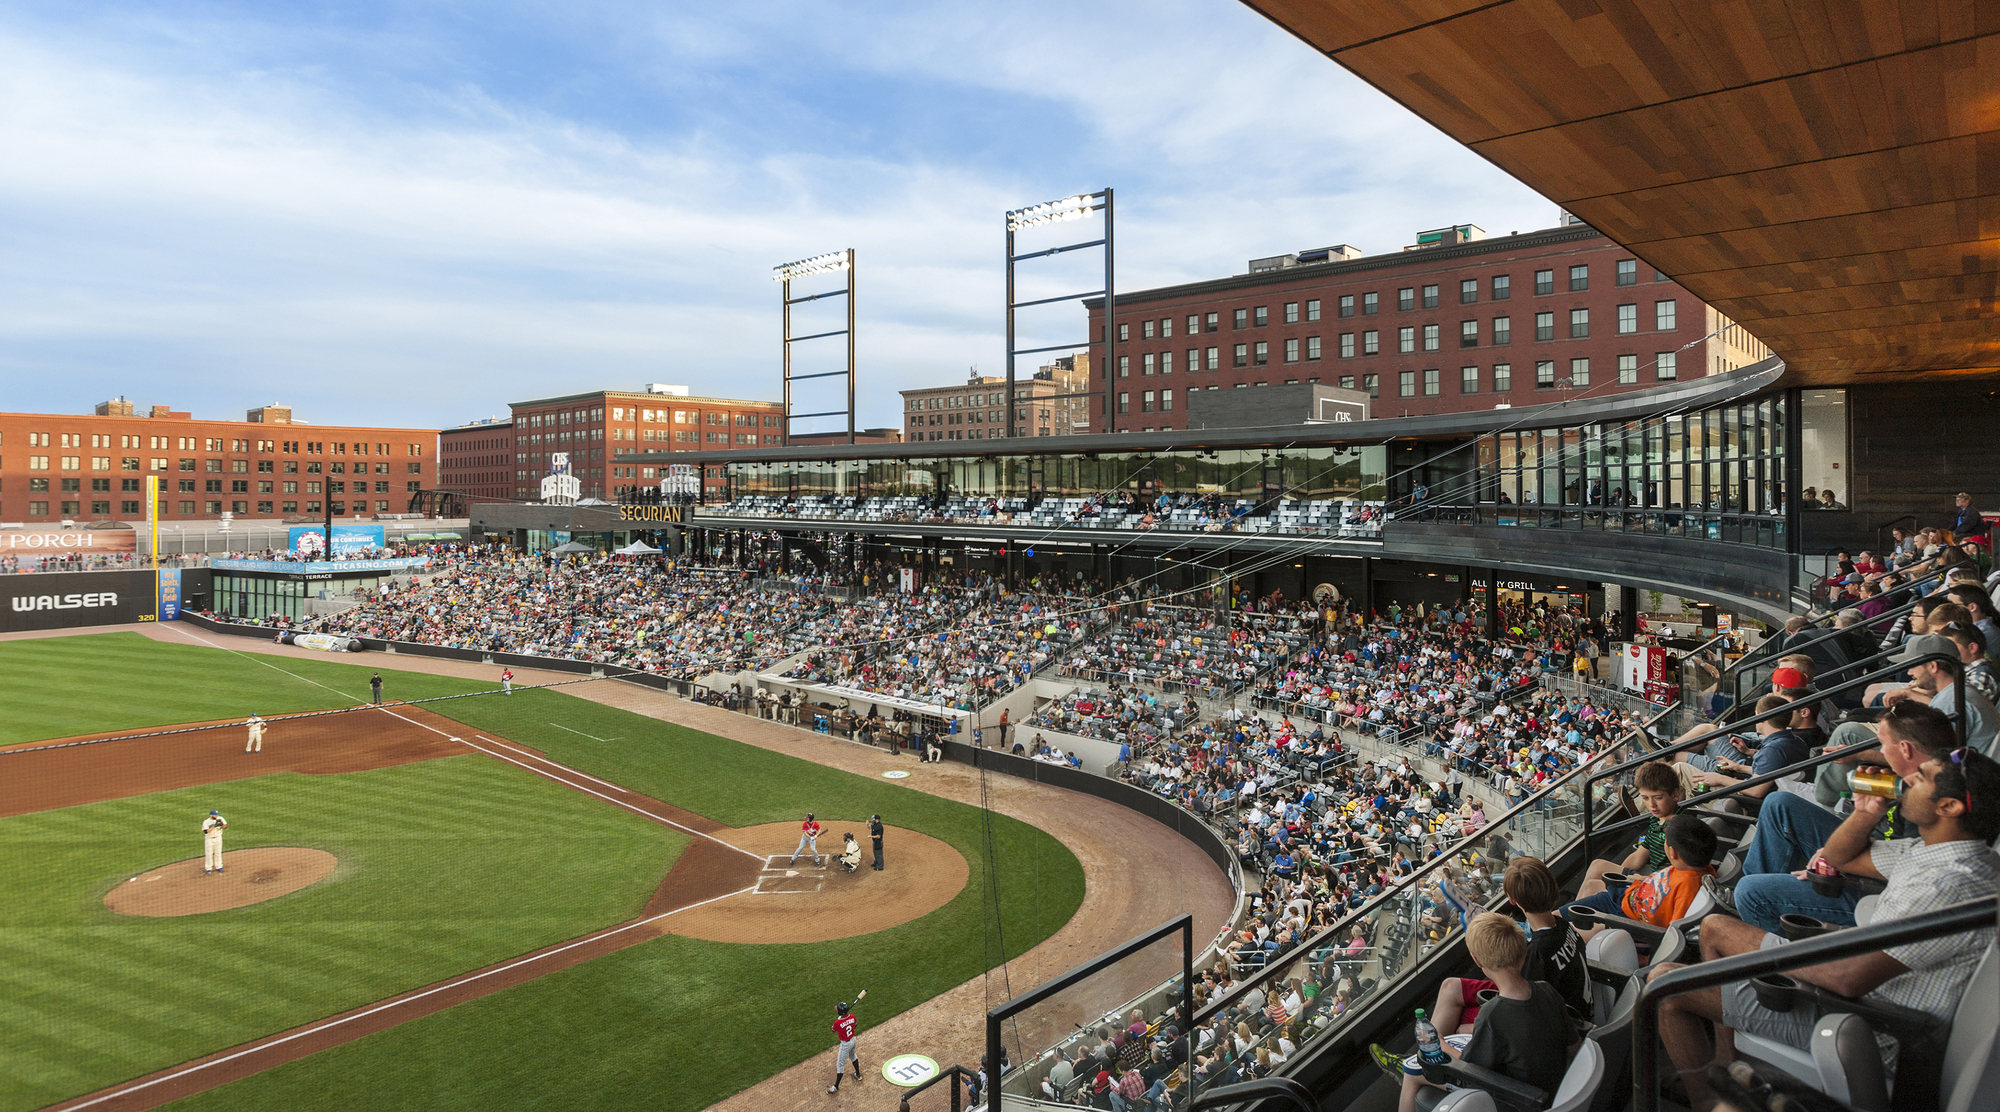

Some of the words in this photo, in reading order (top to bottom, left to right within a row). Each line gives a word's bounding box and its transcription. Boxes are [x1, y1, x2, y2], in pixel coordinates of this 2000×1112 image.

[620, 505, 681, 522] SECURIAN
[10, 533, 93, 548] PORCH
[239, 561, 256, 569] ISLAND
[278, 563, 297, 571] CASINO
[333, 560, 404, 570] TICASINO.COM
[1507, 581, 1536, 590] GRILL
[12, 592, 118, 612] WALSER
[138, 614, 155, 622] 320
[845, 1025, 853, 1037] 2
[892, 1063, 931, 1081] in
